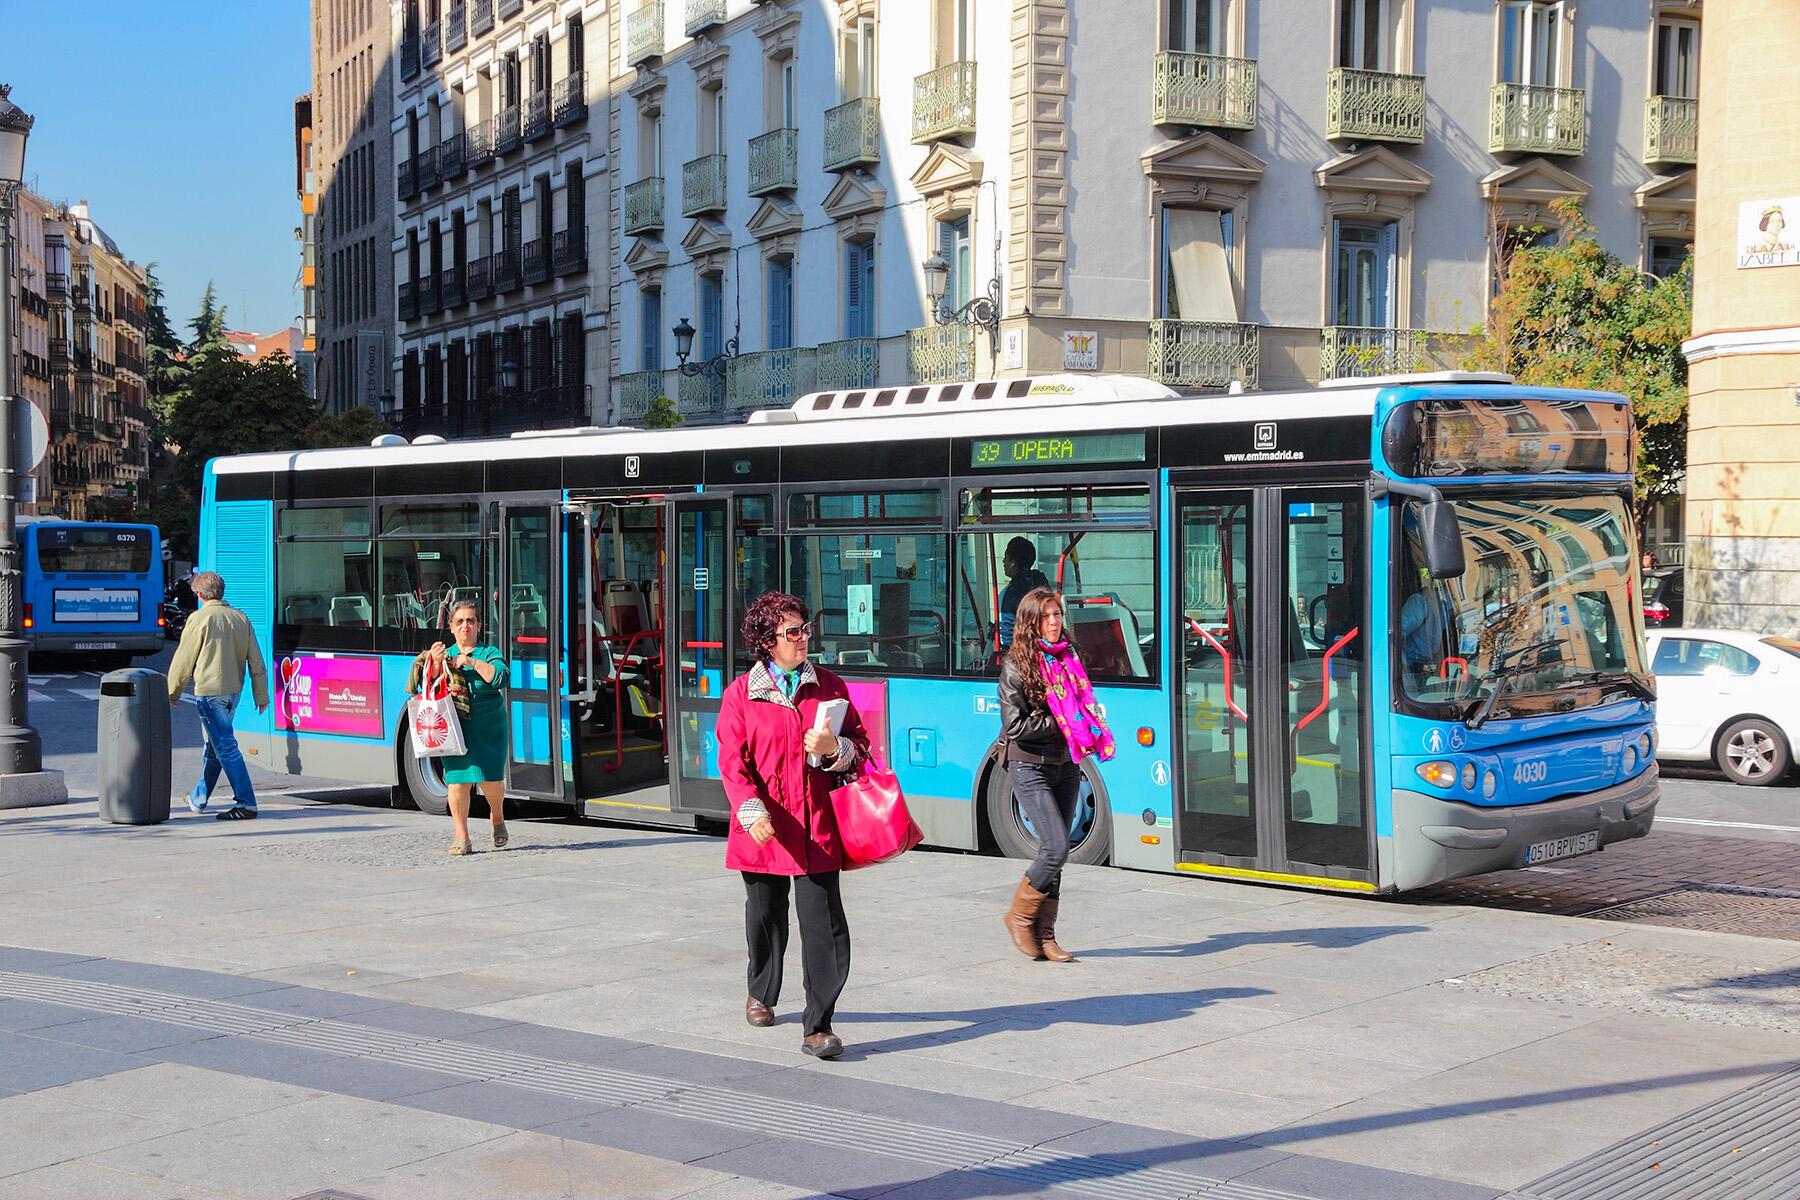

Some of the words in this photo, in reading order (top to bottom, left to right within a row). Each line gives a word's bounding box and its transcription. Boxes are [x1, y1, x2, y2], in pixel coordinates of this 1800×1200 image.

[1746, 243, 1785, 253] PLAZA
[368, 379, 376, 391] La
[368, 394, 376, 406] de
[977, 442, 1000, 462] 39
[1013, 439, 1073, 461] OPERA
[1223, 450, 1304, 462] www.emtmadrid.es
[116, 534, 136, 542] 6370
[1513, 761, 1547, 784] 4030
[1530, 842, 1555, 862] 0510
[1557, 837, 1576, 856] BPV
